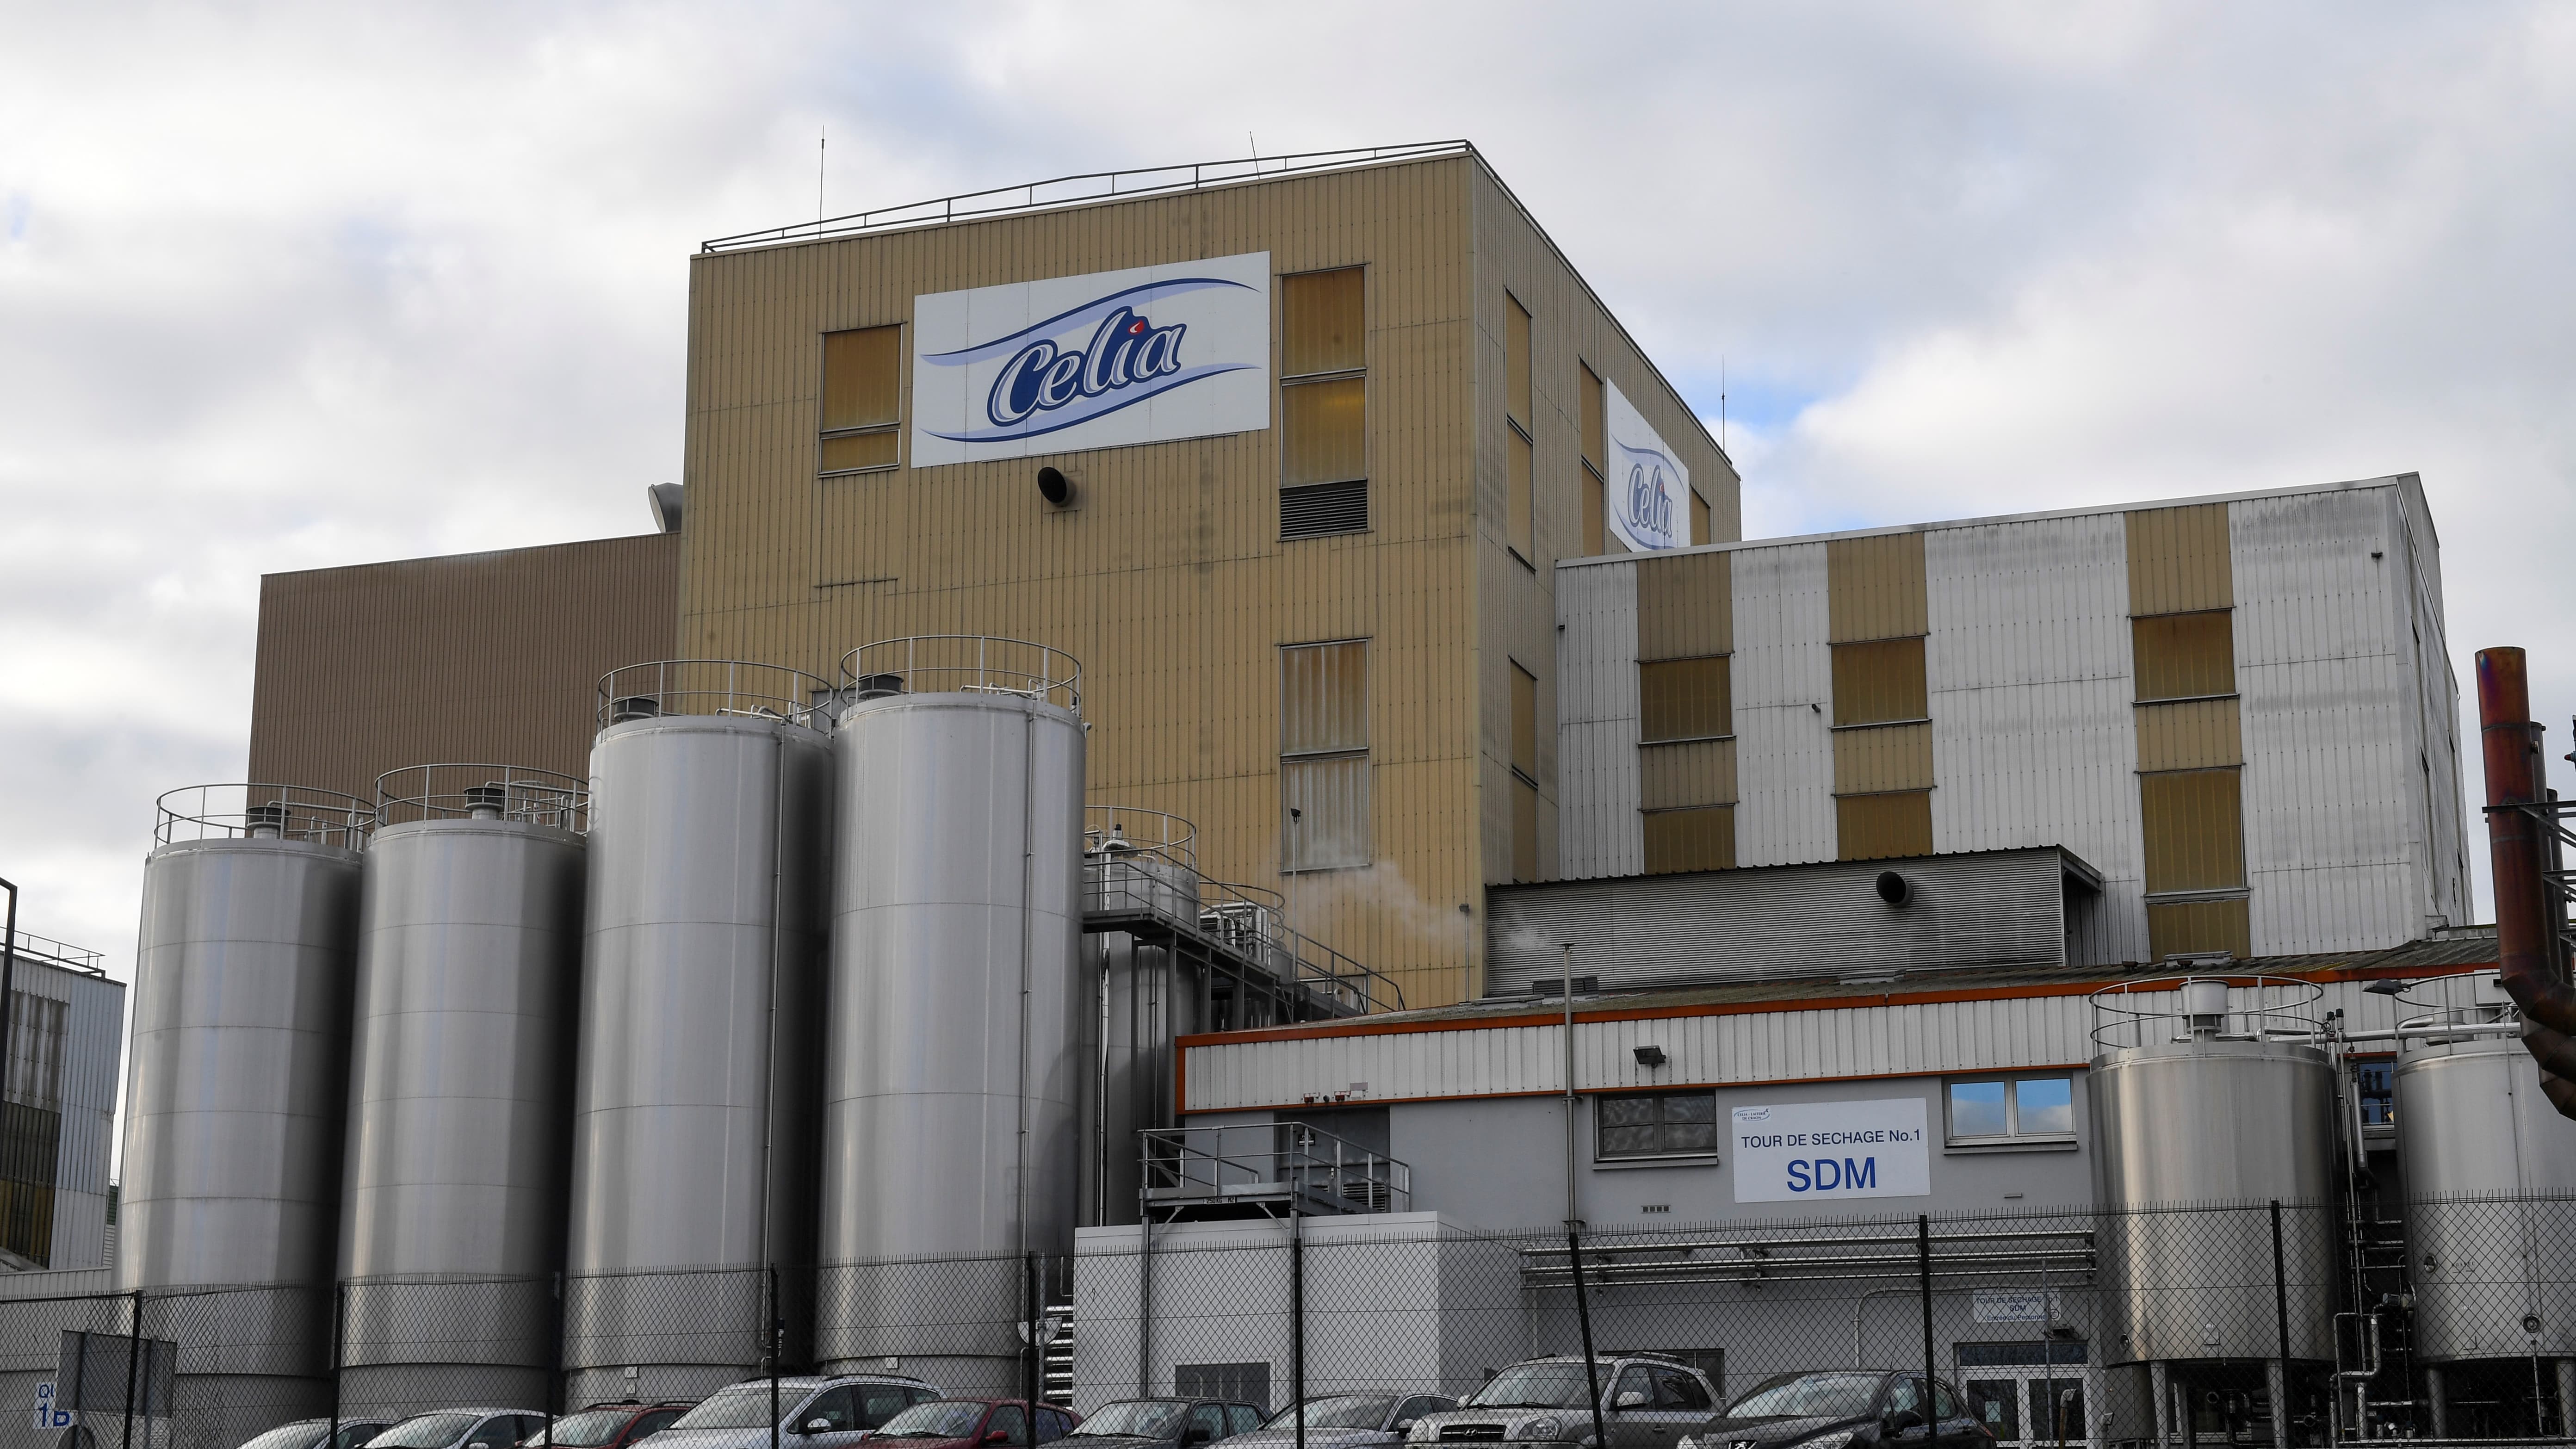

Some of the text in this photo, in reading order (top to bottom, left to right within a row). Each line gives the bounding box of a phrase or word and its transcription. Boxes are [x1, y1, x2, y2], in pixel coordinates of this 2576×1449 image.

[987, 306, 1187, 427] Celia
[1628, 463, 1672, 538] Celia
[1741, 1129, 1920, 1148] TOUR DE SECHAGE No.1
[1787, 1157, 1876, 1192] SDM
